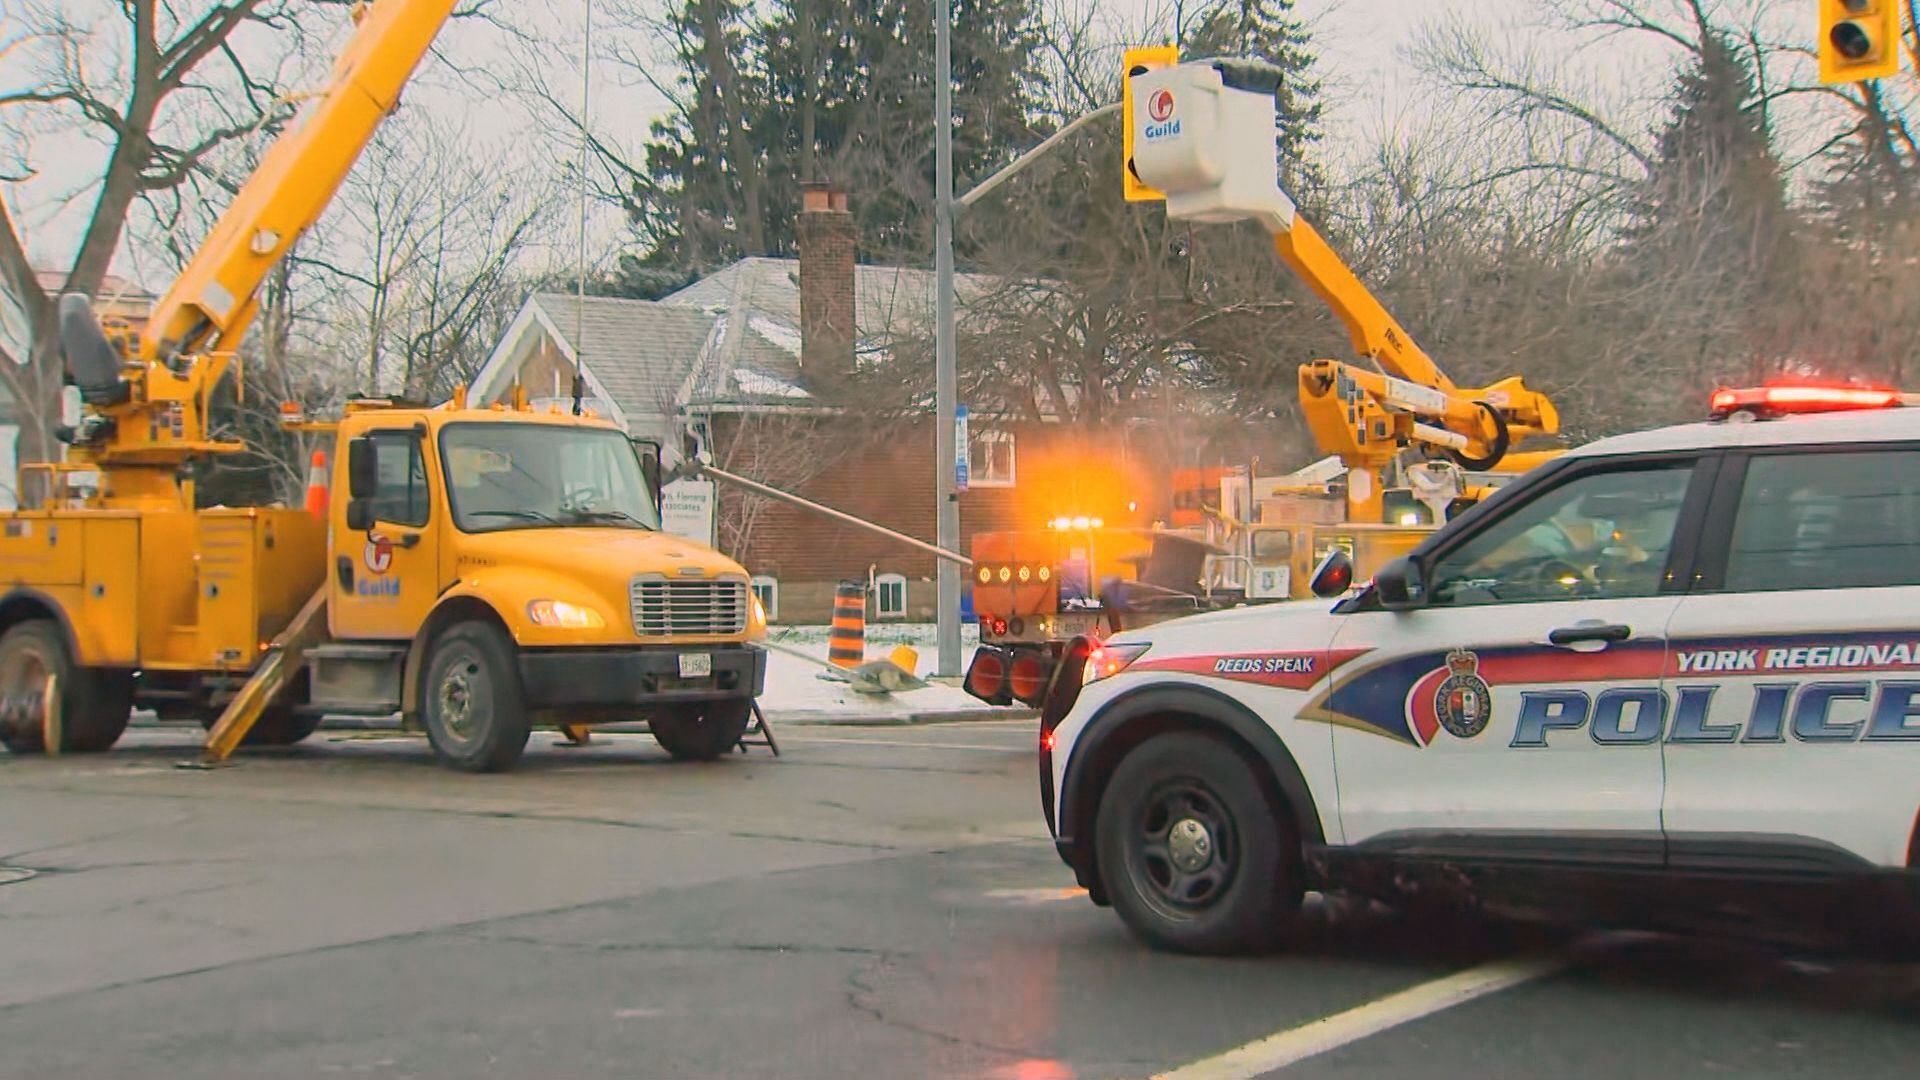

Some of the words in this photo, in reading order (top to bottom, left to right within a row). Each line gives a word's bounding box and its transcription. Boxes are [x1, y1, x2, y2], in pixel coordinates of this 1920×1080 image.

[1145, 120, 1181, 138] Guild
[661, 503, 701, 512] ssociates
[358, 577, 400, 596] Guild
[1213, 657, 1263, 672] DEEDS
[1264, 656, 1314, 672] SPEAK
[1677, 649, 1759, 672] YORK
[1508, 679, 1920, 748] POLICE
